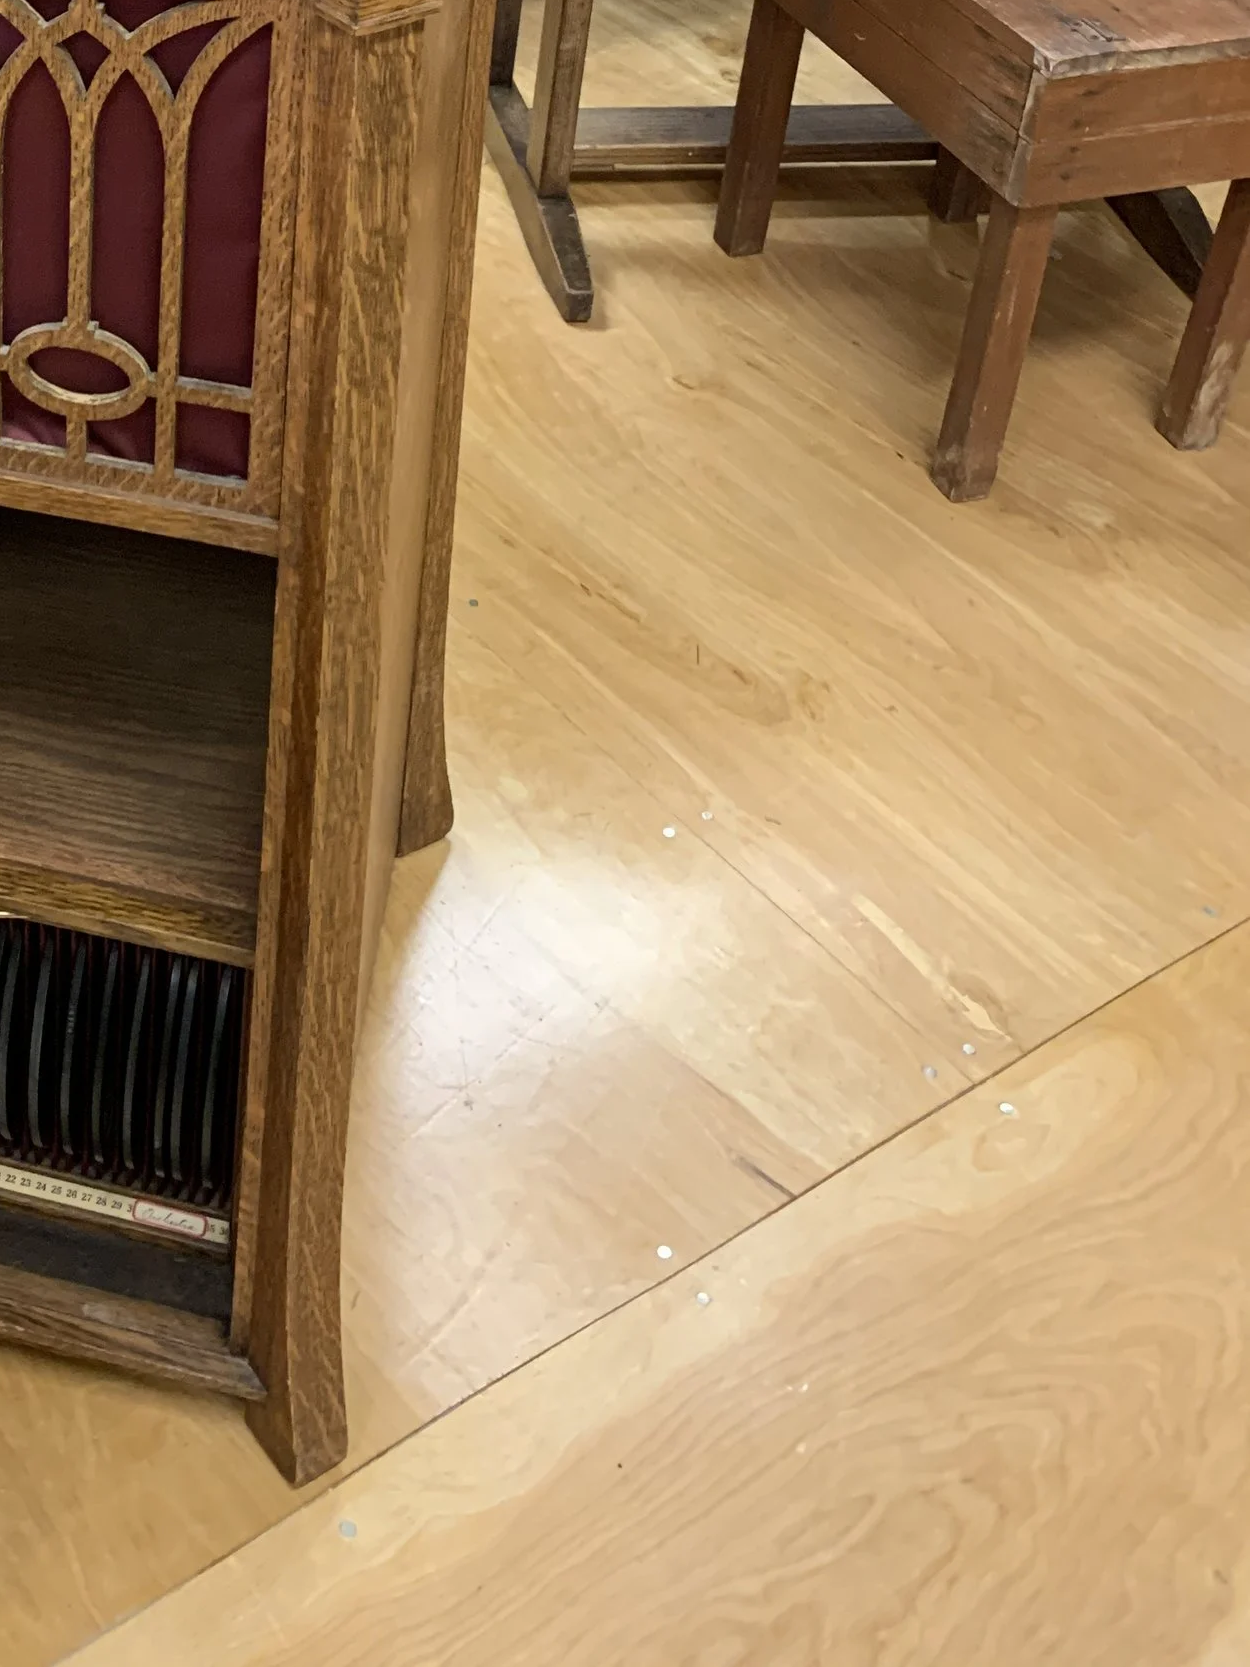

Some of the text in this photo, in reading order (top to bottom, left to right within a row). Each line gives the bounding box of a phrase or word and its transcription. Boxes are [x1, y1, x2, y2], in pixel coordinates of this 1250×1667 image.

[5, 1174, 17, 1184] 22
[20, 1177, 32, 1187] 23
[36, 1181, 47, 1191] 24
[51, 1185, 62, 1195] 25
[66, 1189, 78, 1199] 26
[81, 1193, 92, 1202] 27
[96, 1197, 107, 1206] 28
[111, 1200, 122, 1210] 29
